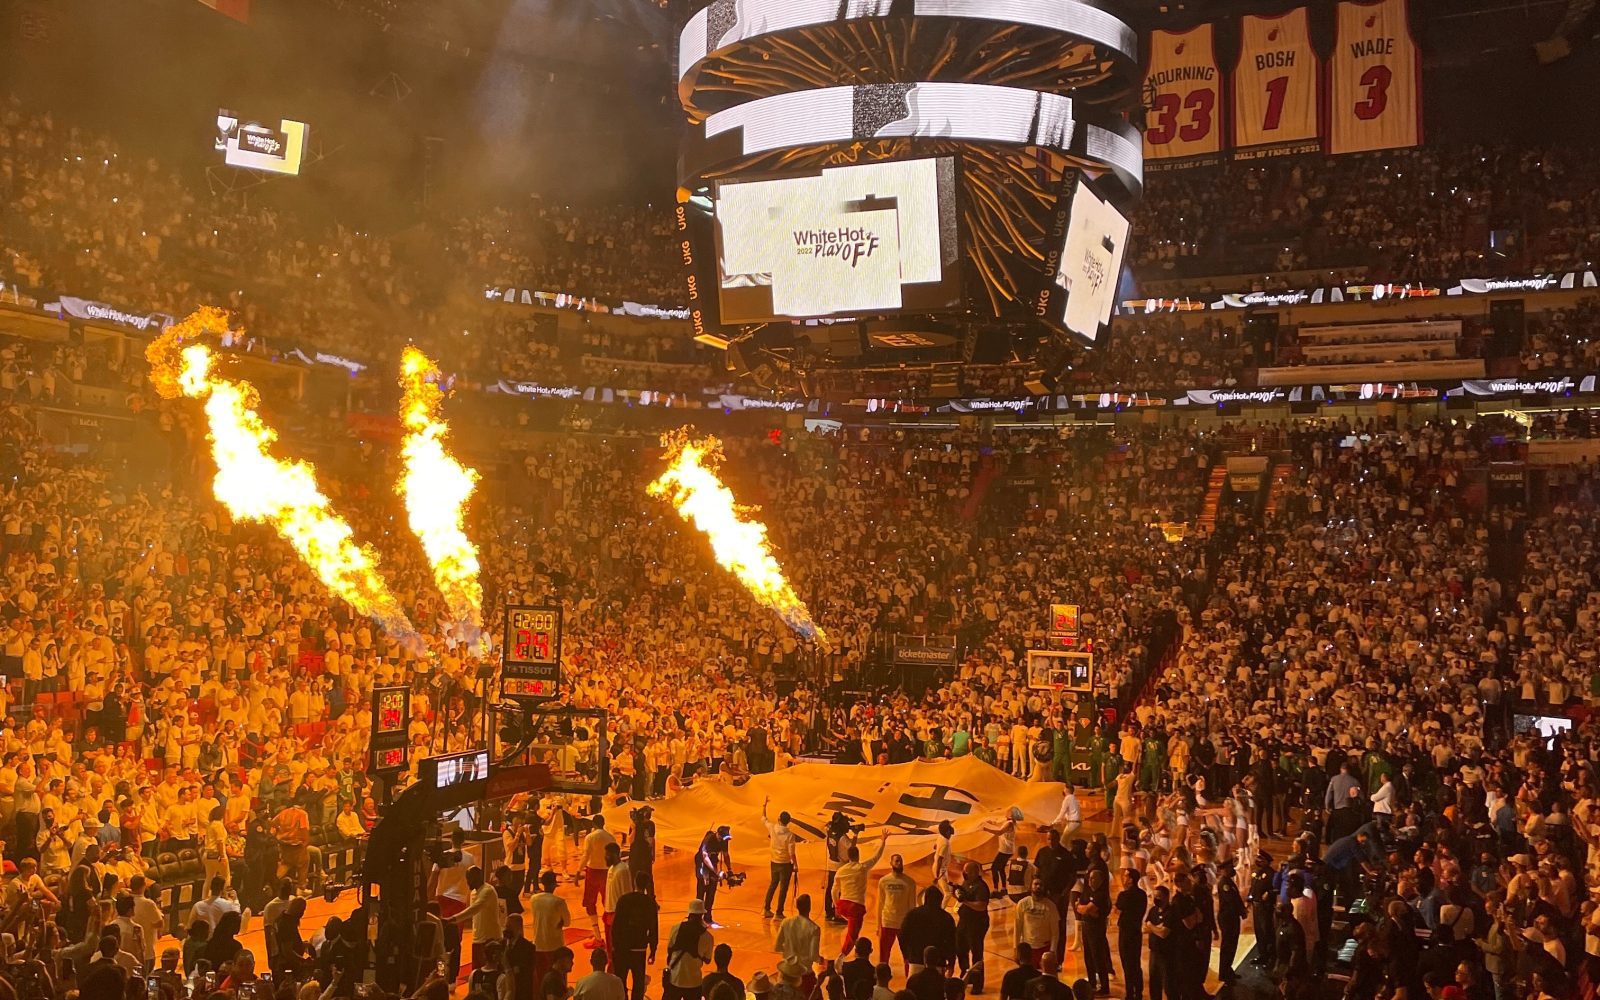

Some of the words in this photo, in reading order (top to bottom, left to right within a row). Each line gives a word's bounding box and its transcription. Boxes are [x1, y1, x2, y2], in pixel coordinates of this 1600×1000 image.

[1350, 38, 1395, 58] WADE
[1255, 51, 1296, 71] BOSH
[1148, 66, 1215, 86] MOURNING
[1262, 76, 1289, 131] 1
[1354, 65, 1392, 120] 3
[1147, 88, 1215, 145] 33
[1268, 148, 1291, 157] FAME
[1063, 171, 1075, 197] UKG
[676, 206, 687, 231] UKG
[1054, 210, 1066, 237] UKG
[793, 229, 837, 245] White
[838, 227, 865, 242] Hot
[681, 240, 692, 265] UKG
[1044, 250, 1058, 277] UKG
[687, 275, 698, 300] UKG
[1036, 289, 1050, 316] UKG
[693, 310, 704, 335] UKG
[515, 630, 549, 660] 24
[898, 649, 950, 660] ticketmaster
[519, 666, 553, 675] TISSOT
